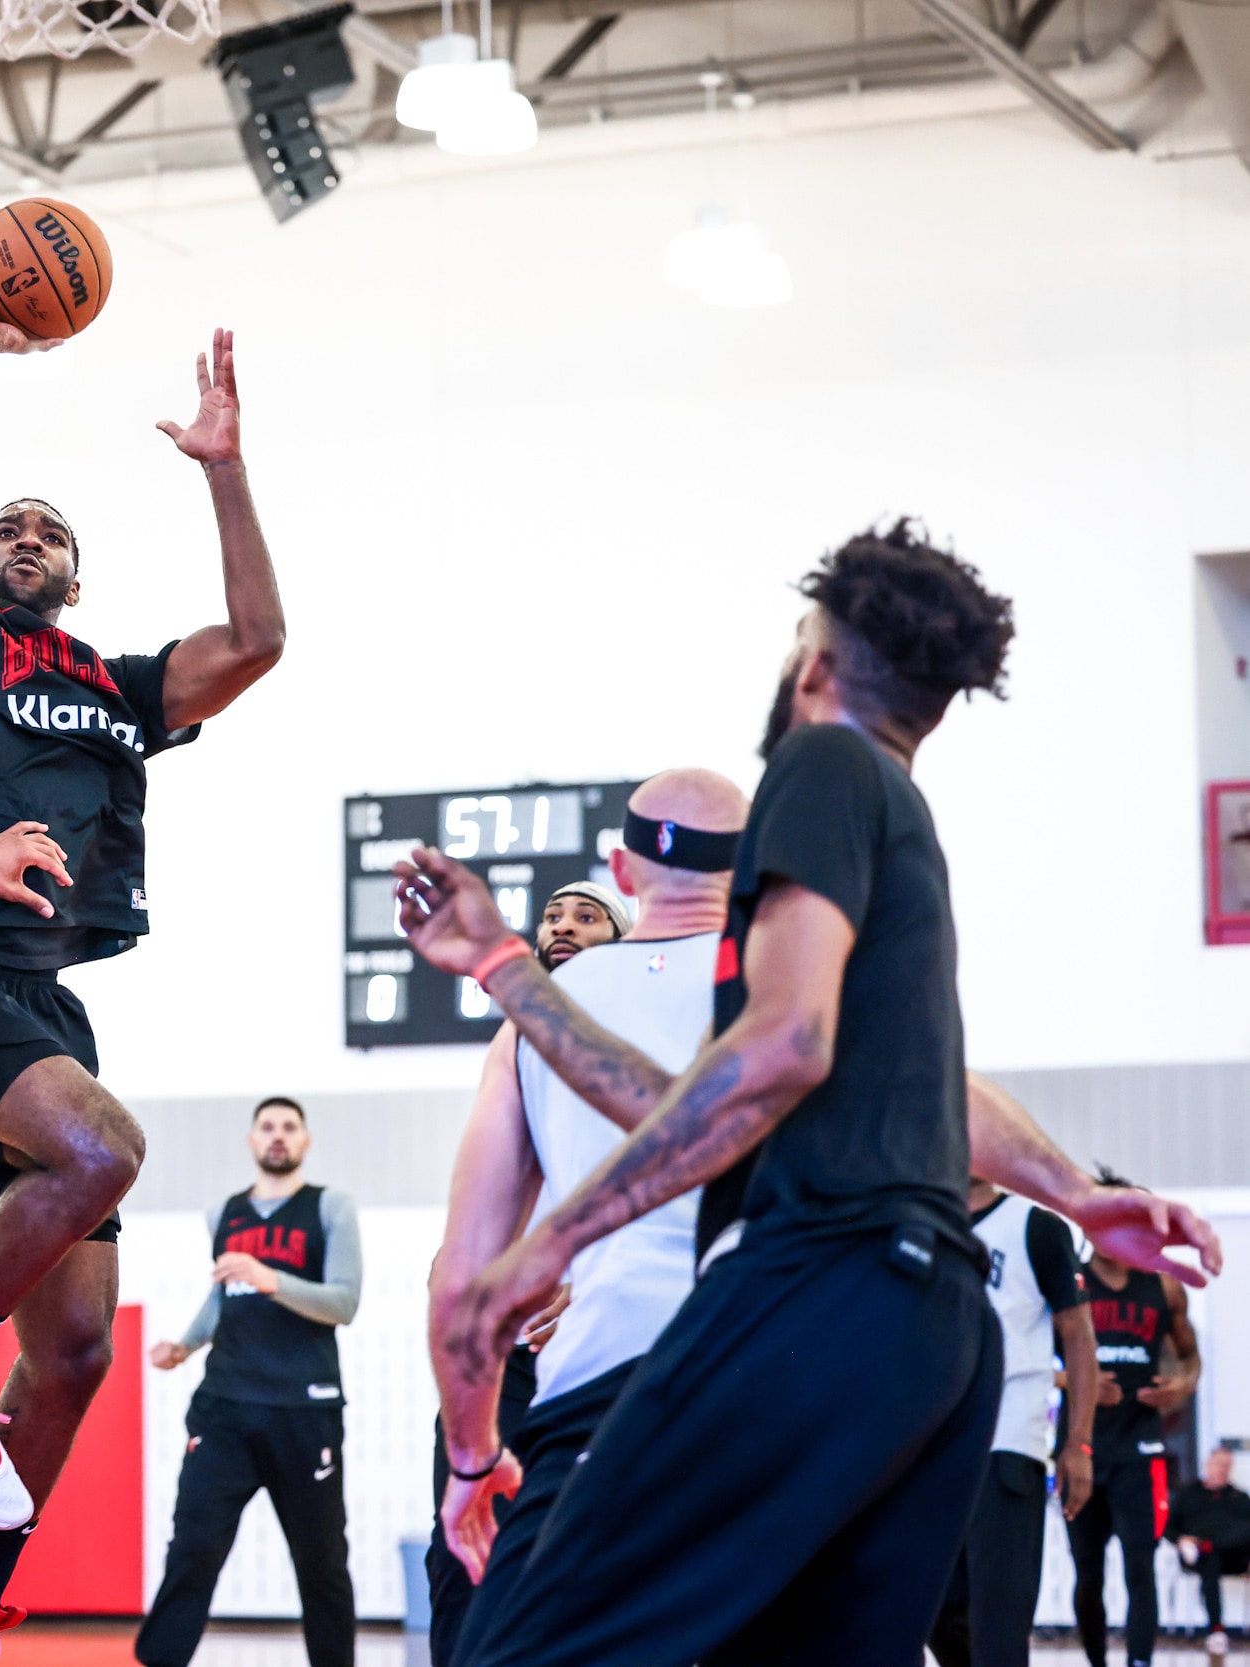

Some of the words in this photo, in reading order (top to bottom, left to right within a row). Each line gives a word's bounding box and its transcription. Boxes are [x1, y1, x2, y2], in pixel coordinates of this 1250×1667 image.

[35, 213, 89, 308] Wilson
[1, 626, 122, 696] BULL
[7, 694, 145, 753] Klarna.
[1093, 1299, 1158, 1343] ULLS
